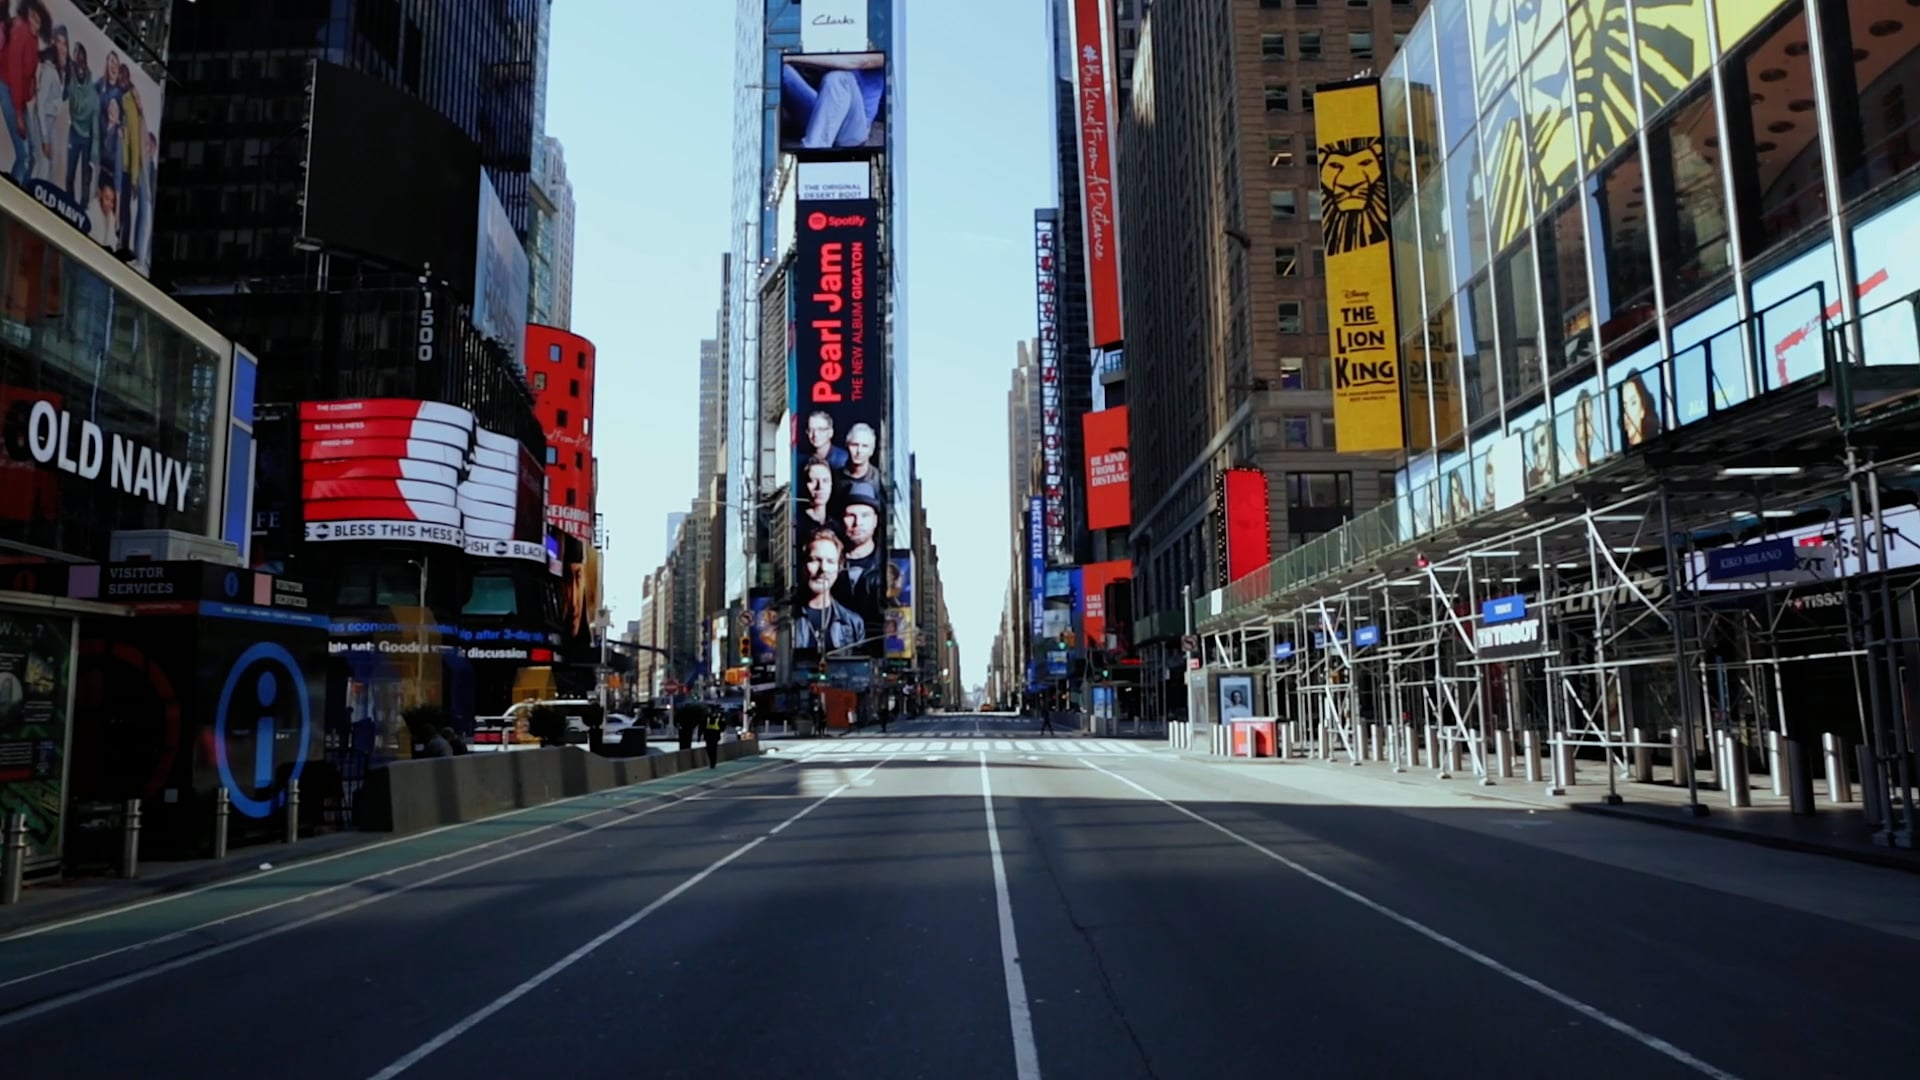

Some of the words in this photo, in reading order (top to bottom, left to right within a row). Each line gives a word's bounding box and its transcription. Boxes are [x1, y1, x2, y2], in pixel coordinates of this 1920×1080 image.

[811, 14, 855, 26] Clarks
[822, 183, 861, 191] ORIGINAL
[838, 191, 862, 199] BOOT
[34, 184, 57, 208] OLD
[57, 199, 86, 229] NAVY
[828, 215, 866, 228] Spotify
[813, 242, 842, 313] Jam
[852, 242, 863, 300] GIGATON
[852, 302, 863, 344] ALBUM
[1341, 306, 1375, 322] THE
[417, 291, 434, 361] 1500
[1337, 327, 1385, 354] LION
[812, 320, 842, 402] Pearl
[852, 347, 863, 375] NEW
[1335, 357, 1394, 389] KING
[852, 377, 863, 401] THE
[28, 400, 104, 480] OLD
[110, 433, 192, 513] NAVY
[1104, 450, 1126, 464] KIND
[1092, 464, 1116, 476] FROM
[1118, 462, 1124, 471] A
[1092, 472, 1129, 487] DISTANC
[334, 524, 375, 537] BLESS
[380, 524, 415, 537] THIS
[420, 526, 453, 541] MESS
[1720, 556, 1741, 568] KIKO
[1744, 549, 1782, 566] MILANO
[110, 567, 164, 578] VISITOR
[108, 582, 174, 595] SERVICES
[467, 647, 528, 659] discussion
